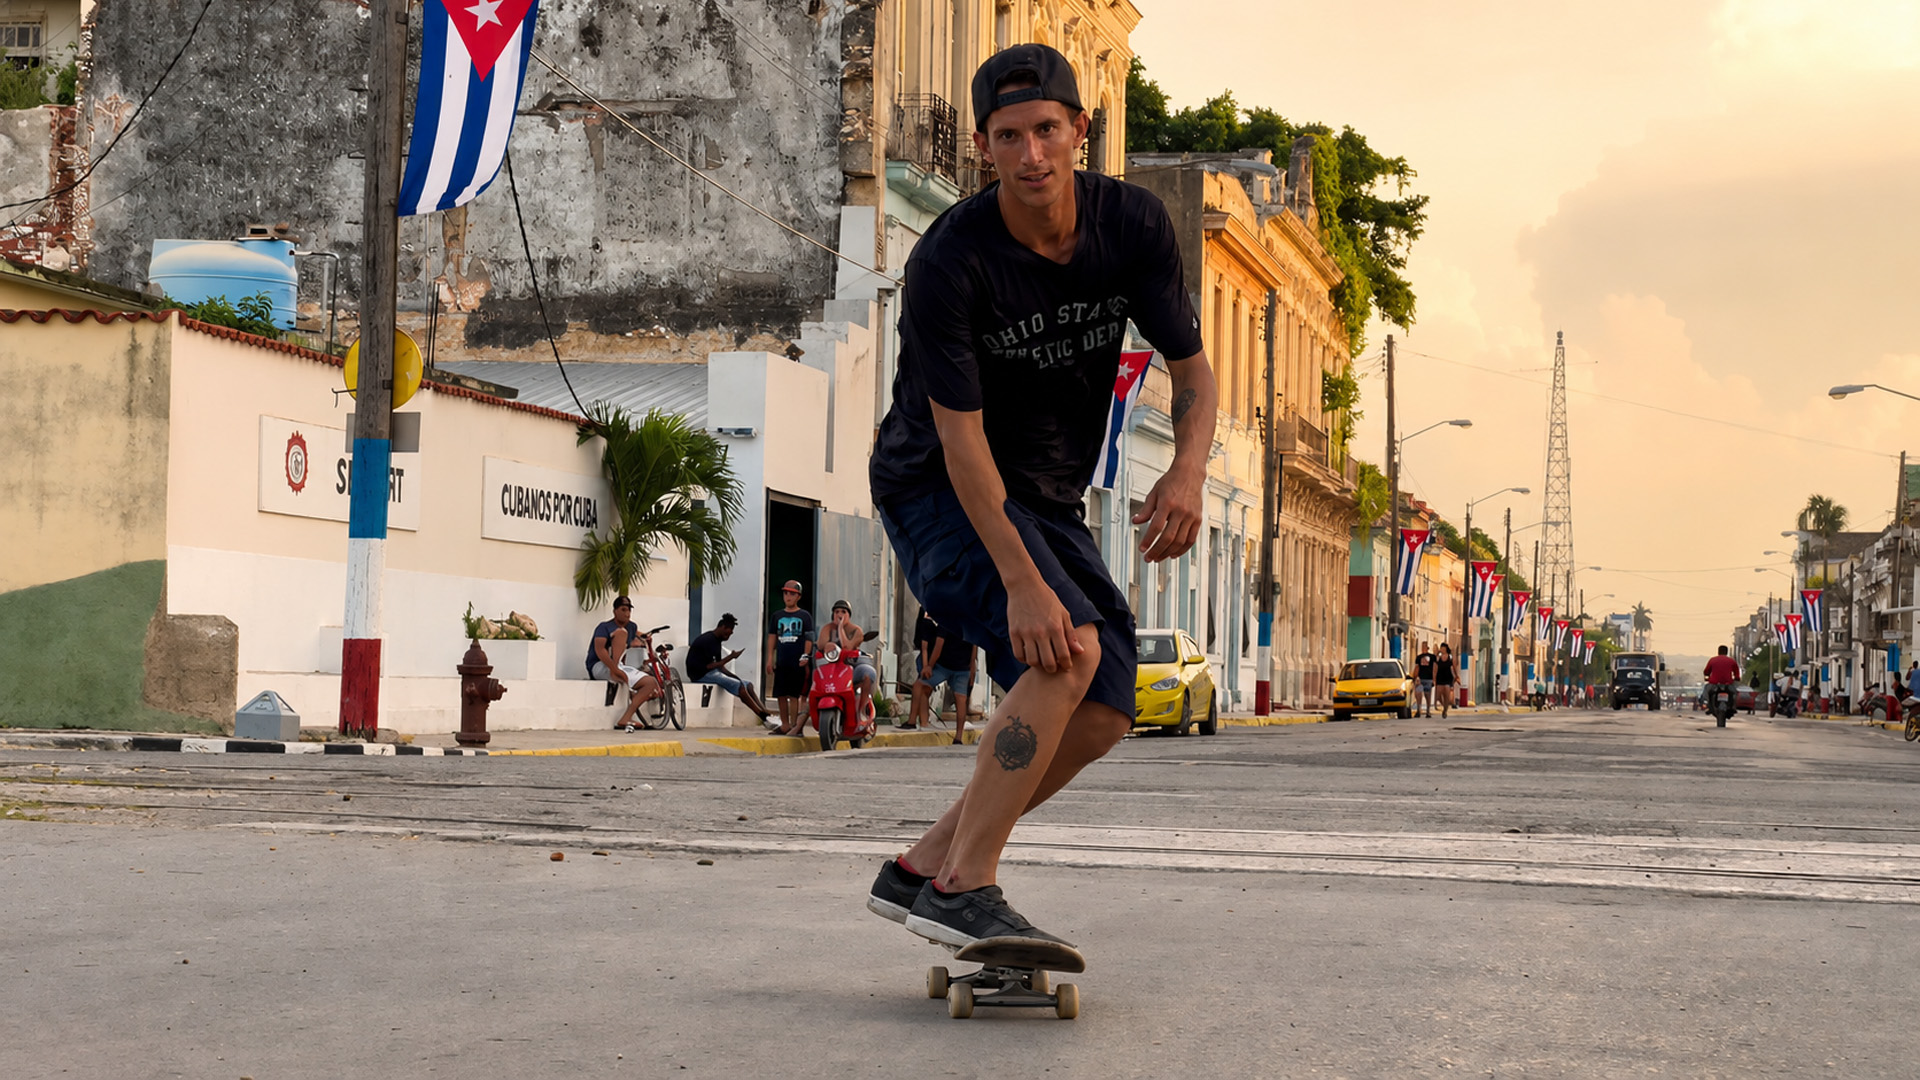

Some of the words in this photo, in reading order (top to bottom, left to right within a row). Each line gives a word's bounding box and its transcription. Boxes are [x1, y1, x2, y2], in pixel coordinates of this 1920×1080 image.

[982, 312, 1044, 349] OHIO
[501, 483, 551, 522] CUBANOS
[553, 492, 572, 525] POR
[573, 495, 598, 529] CUBA
